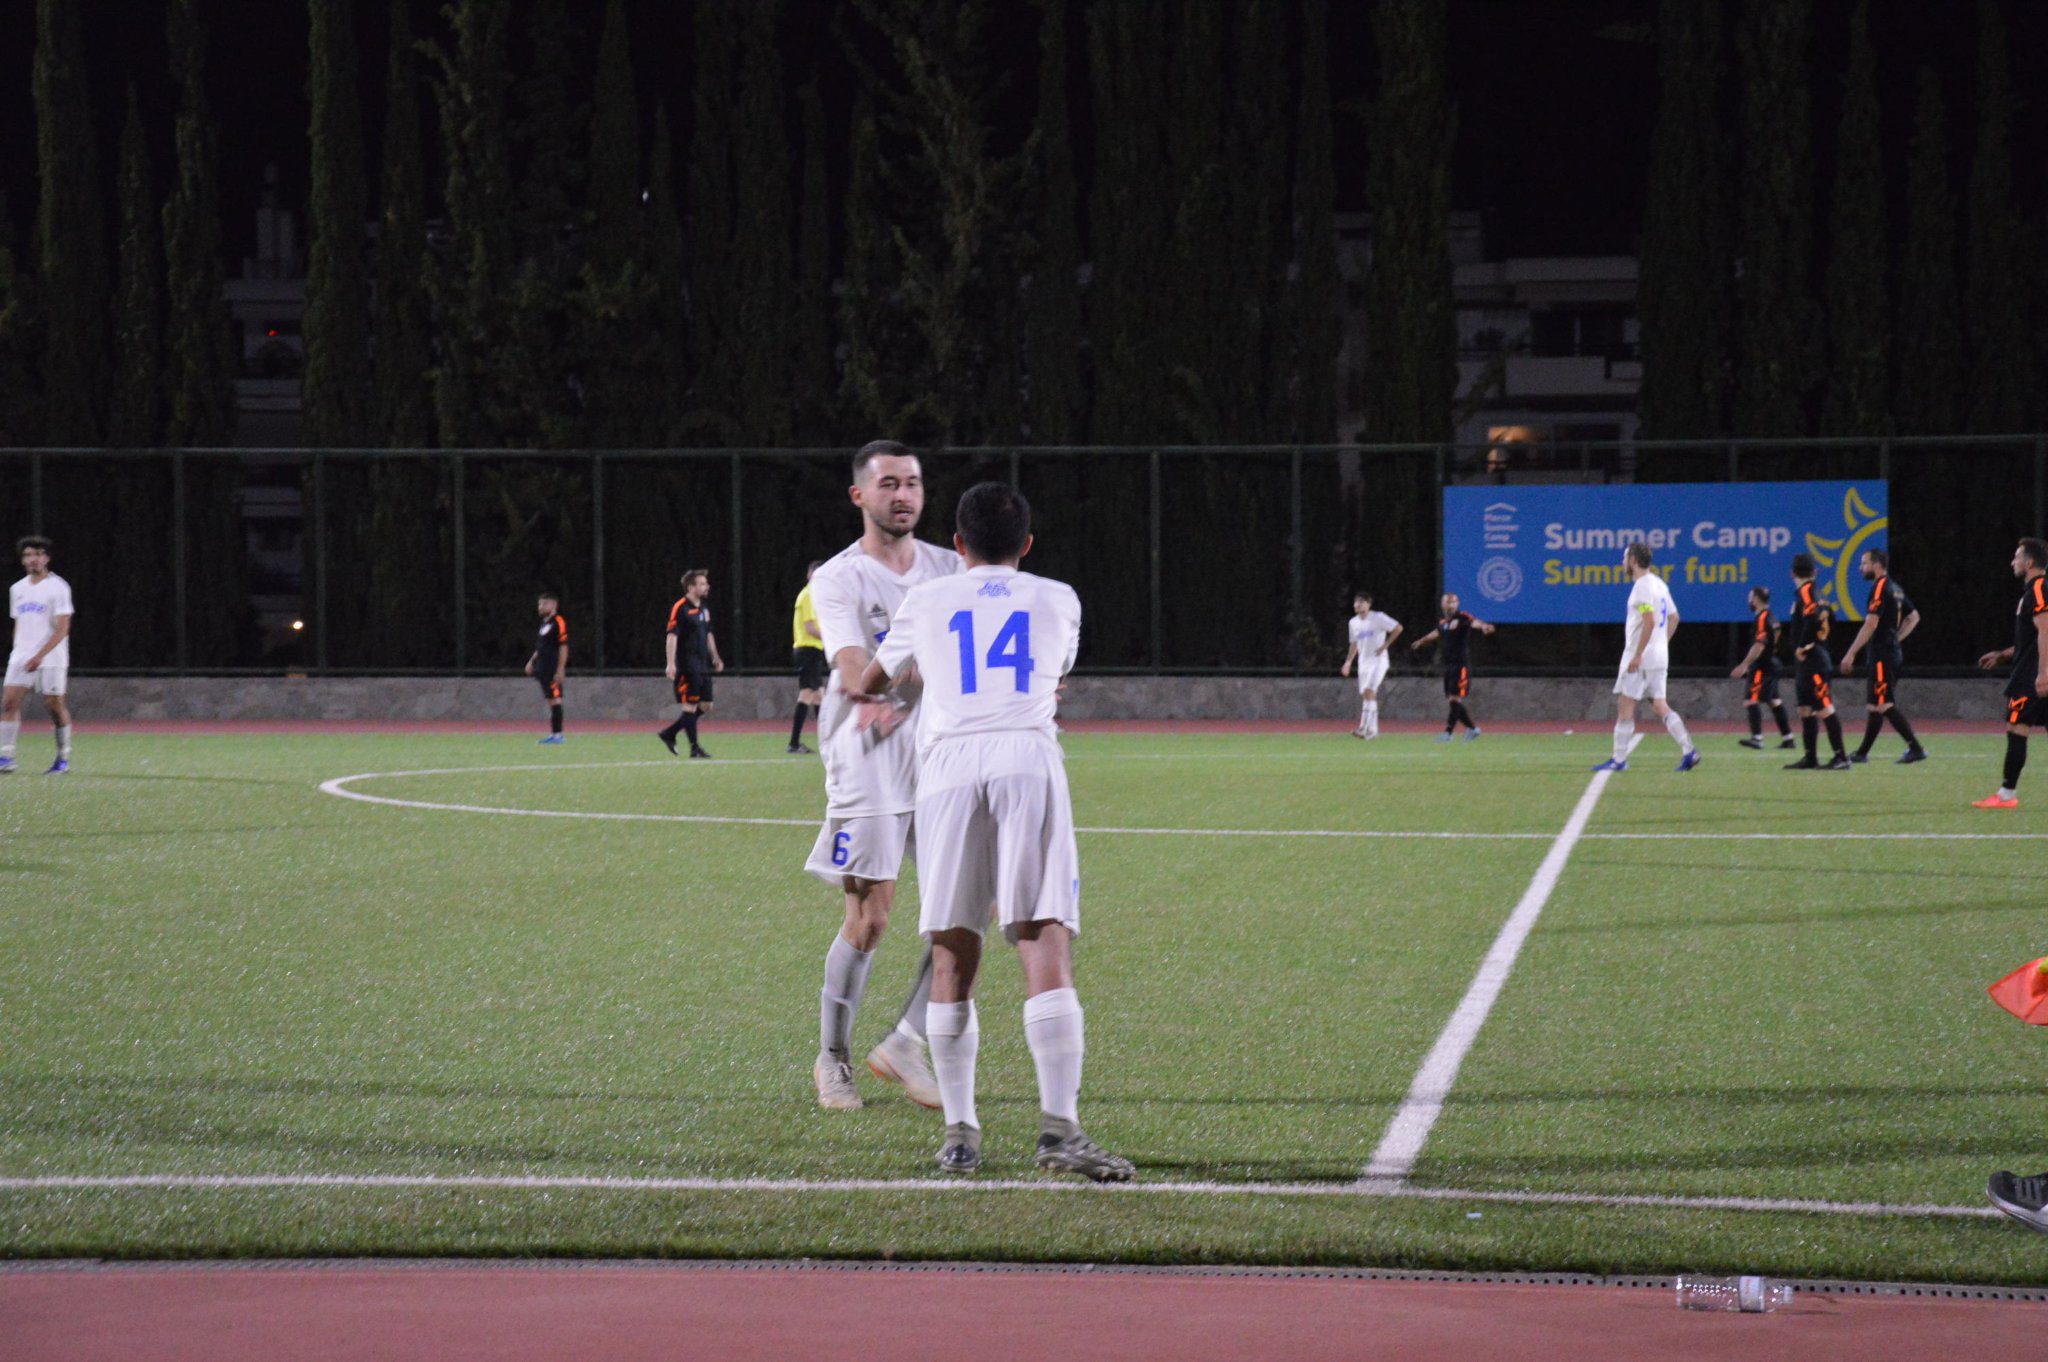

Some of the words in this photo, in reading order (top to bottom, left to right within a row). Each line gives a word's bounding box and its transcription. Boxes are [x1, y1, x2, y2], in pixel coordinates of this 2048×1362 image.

[1544, 522, 1681, 550] Summer
[1692, 520, 1791, 554] Camp
[1685, 556, 1748, 583] fun!
[948, 609, 1035, 695] 14
[831, 831, 851, 866] 6
